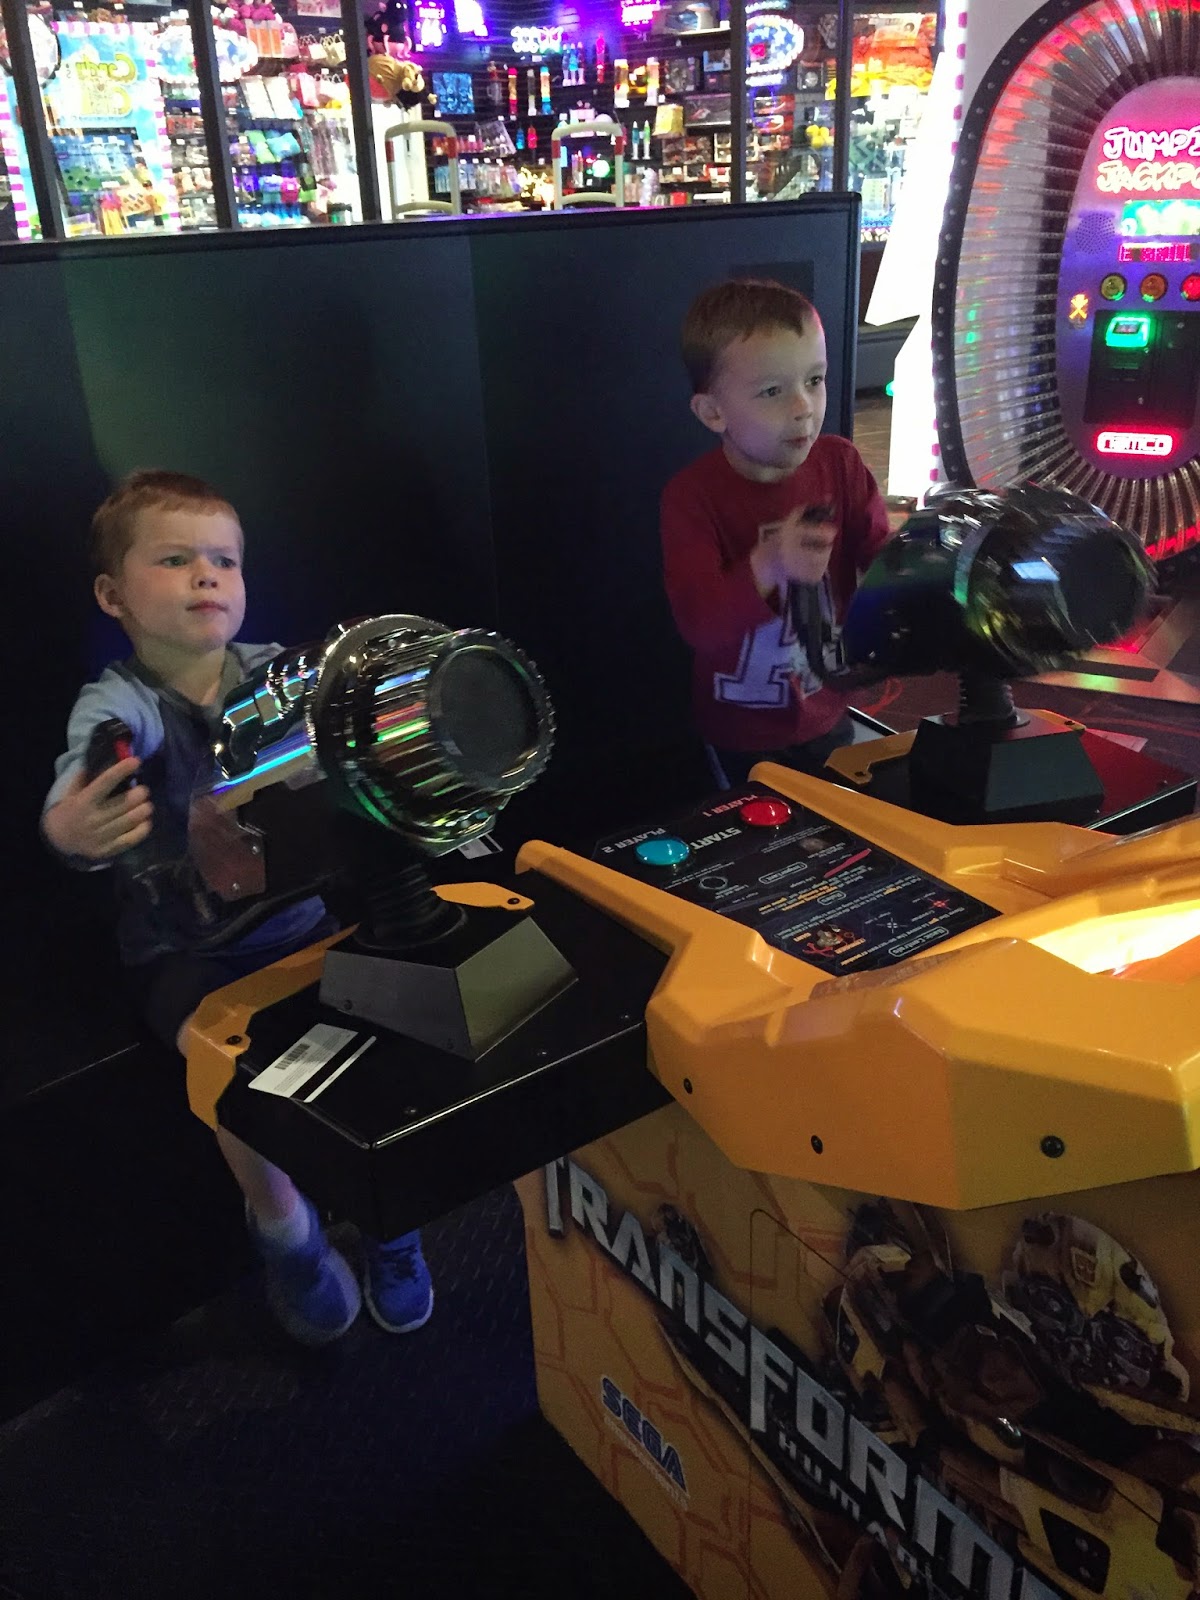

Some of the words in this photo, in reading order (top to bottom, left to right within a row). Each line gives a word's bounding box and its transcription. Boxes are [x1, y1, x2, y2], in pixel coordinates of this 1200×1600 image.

[614, 827, 666, 849] PLAYER
[691, 826, 742, 850] START
[601, 1375, 689, 1496] SEGA
